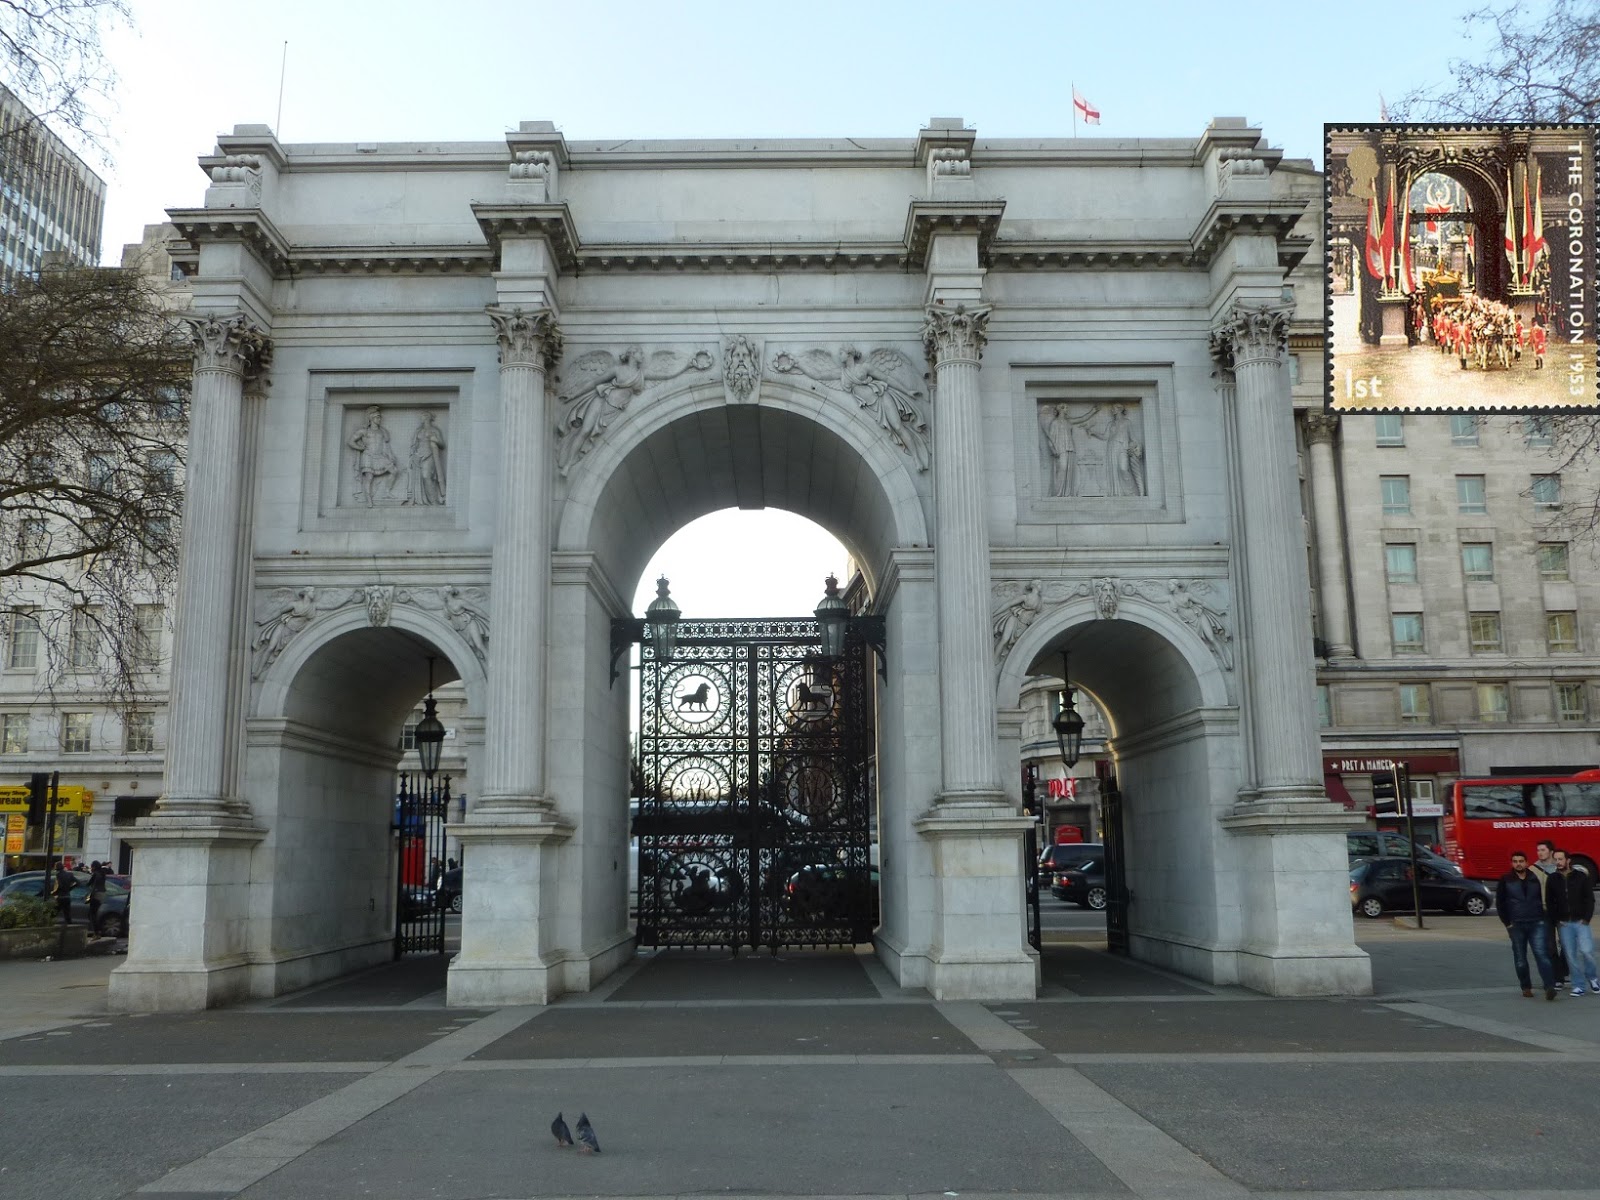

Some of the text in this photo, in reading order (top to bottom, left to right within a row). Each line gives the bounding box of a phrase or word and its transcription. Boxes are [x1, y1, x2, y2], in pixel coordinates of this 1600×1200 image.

[1341, 759, 1358, 771] PRET
[1360, 760, 1366, 771] A
[1048, 777, 1076, 798] PRET
[1493, 821, 1530, 829] BRITAIN'S
